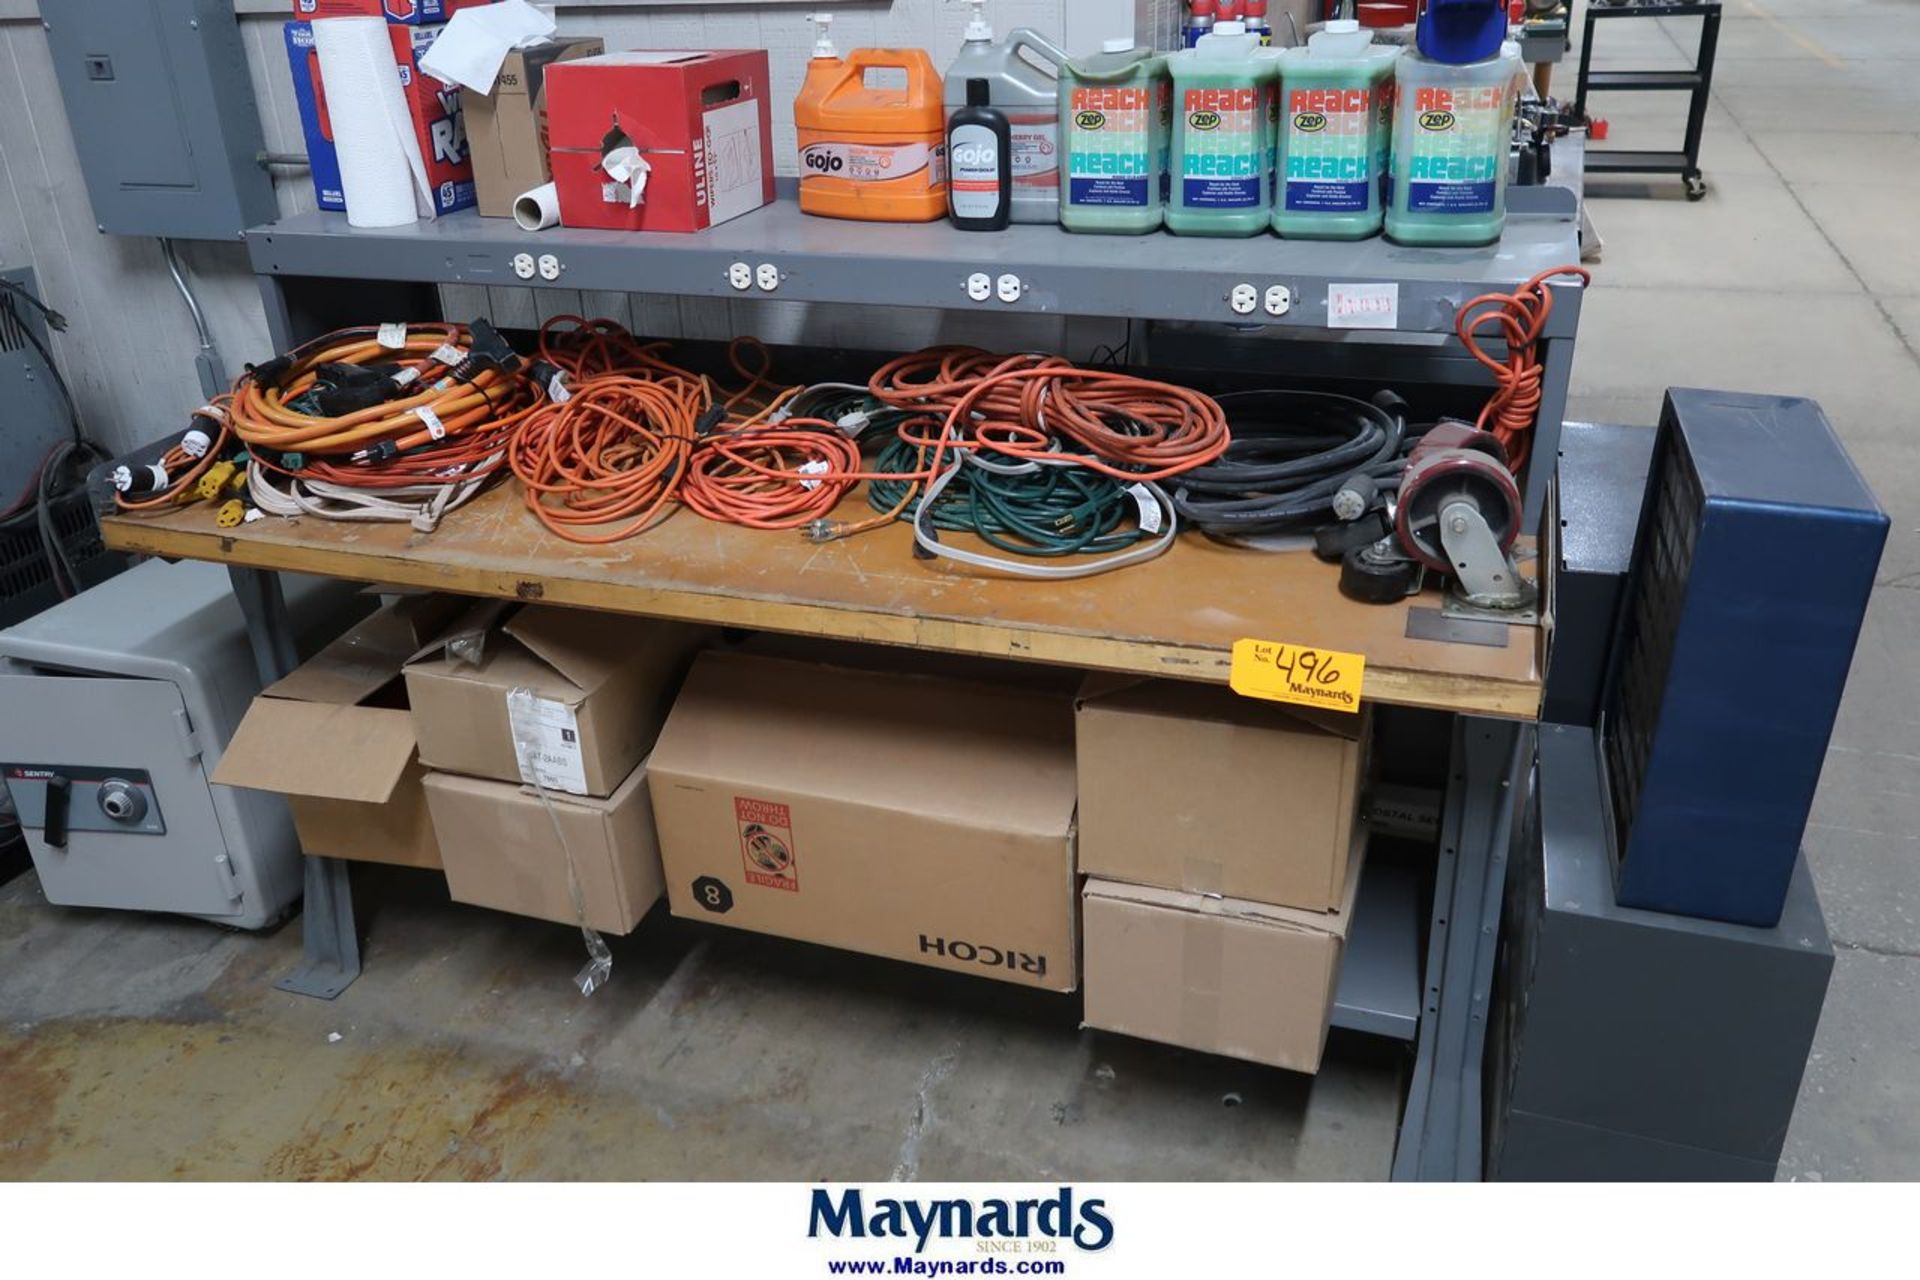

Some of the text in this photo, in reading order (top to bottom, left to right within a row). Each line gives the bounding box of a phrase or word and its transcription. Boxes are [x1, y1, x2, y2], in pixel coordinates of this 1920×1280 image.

[692, 138, 707, 207] ULINE
[1254, 644, 1273, 655] Lot
[1275, 645, 1341, 685] 496
[1289, 682, 1354, 705] Maynards
[24, 769, 55, 778] SENTRY
[739, 800, 786, 817] THROW
[740, 811, 789, 827] DO NOT
[749, 874, 797, 890] FRAGILE
[704, 885, 721, 904] 8
[919, 934, 1046, 976] RICOH
